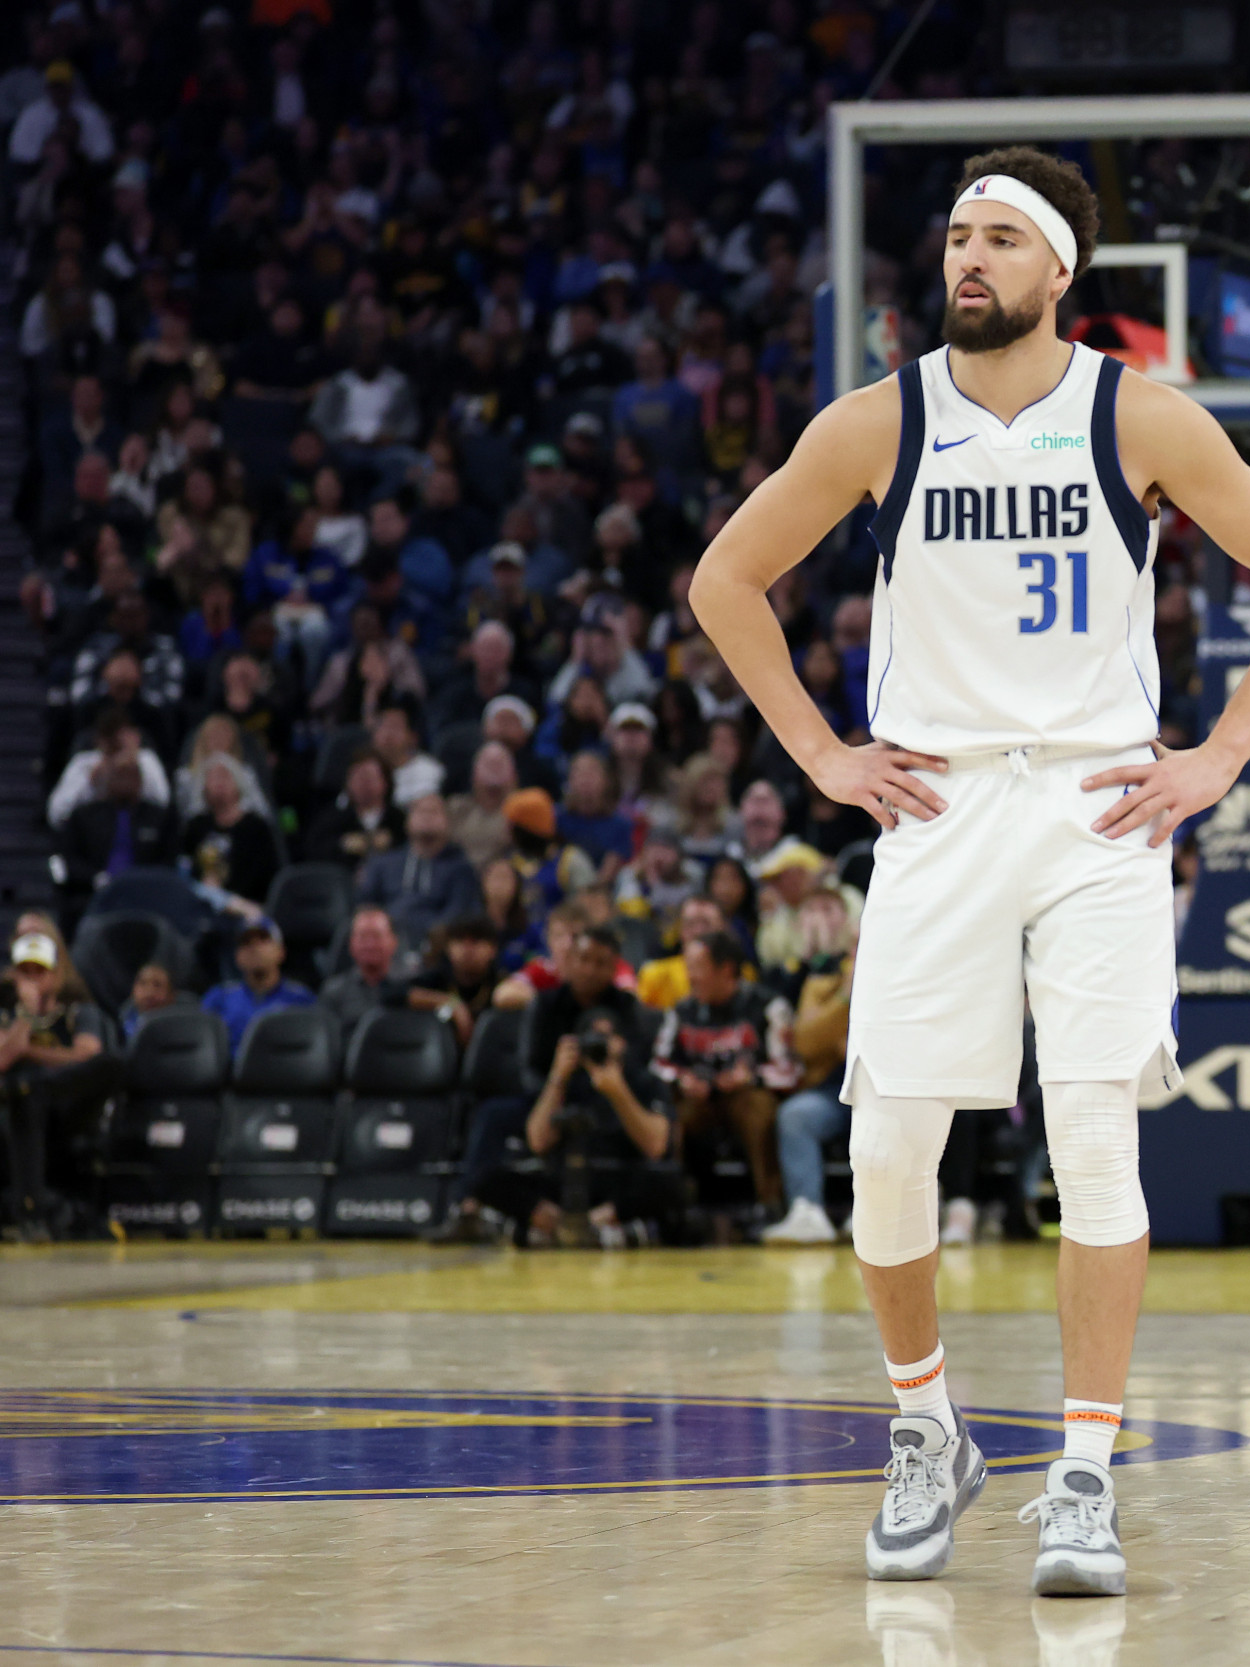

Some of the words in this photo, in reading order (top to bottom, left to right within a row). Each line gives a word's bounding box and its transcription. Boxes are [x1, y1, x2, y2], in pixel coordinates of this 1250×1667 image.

[1030, 432, 1086, 450] chime
[923, 483, 1089, 543] DALLAS
[1017, 551, 1089, 635] 31
